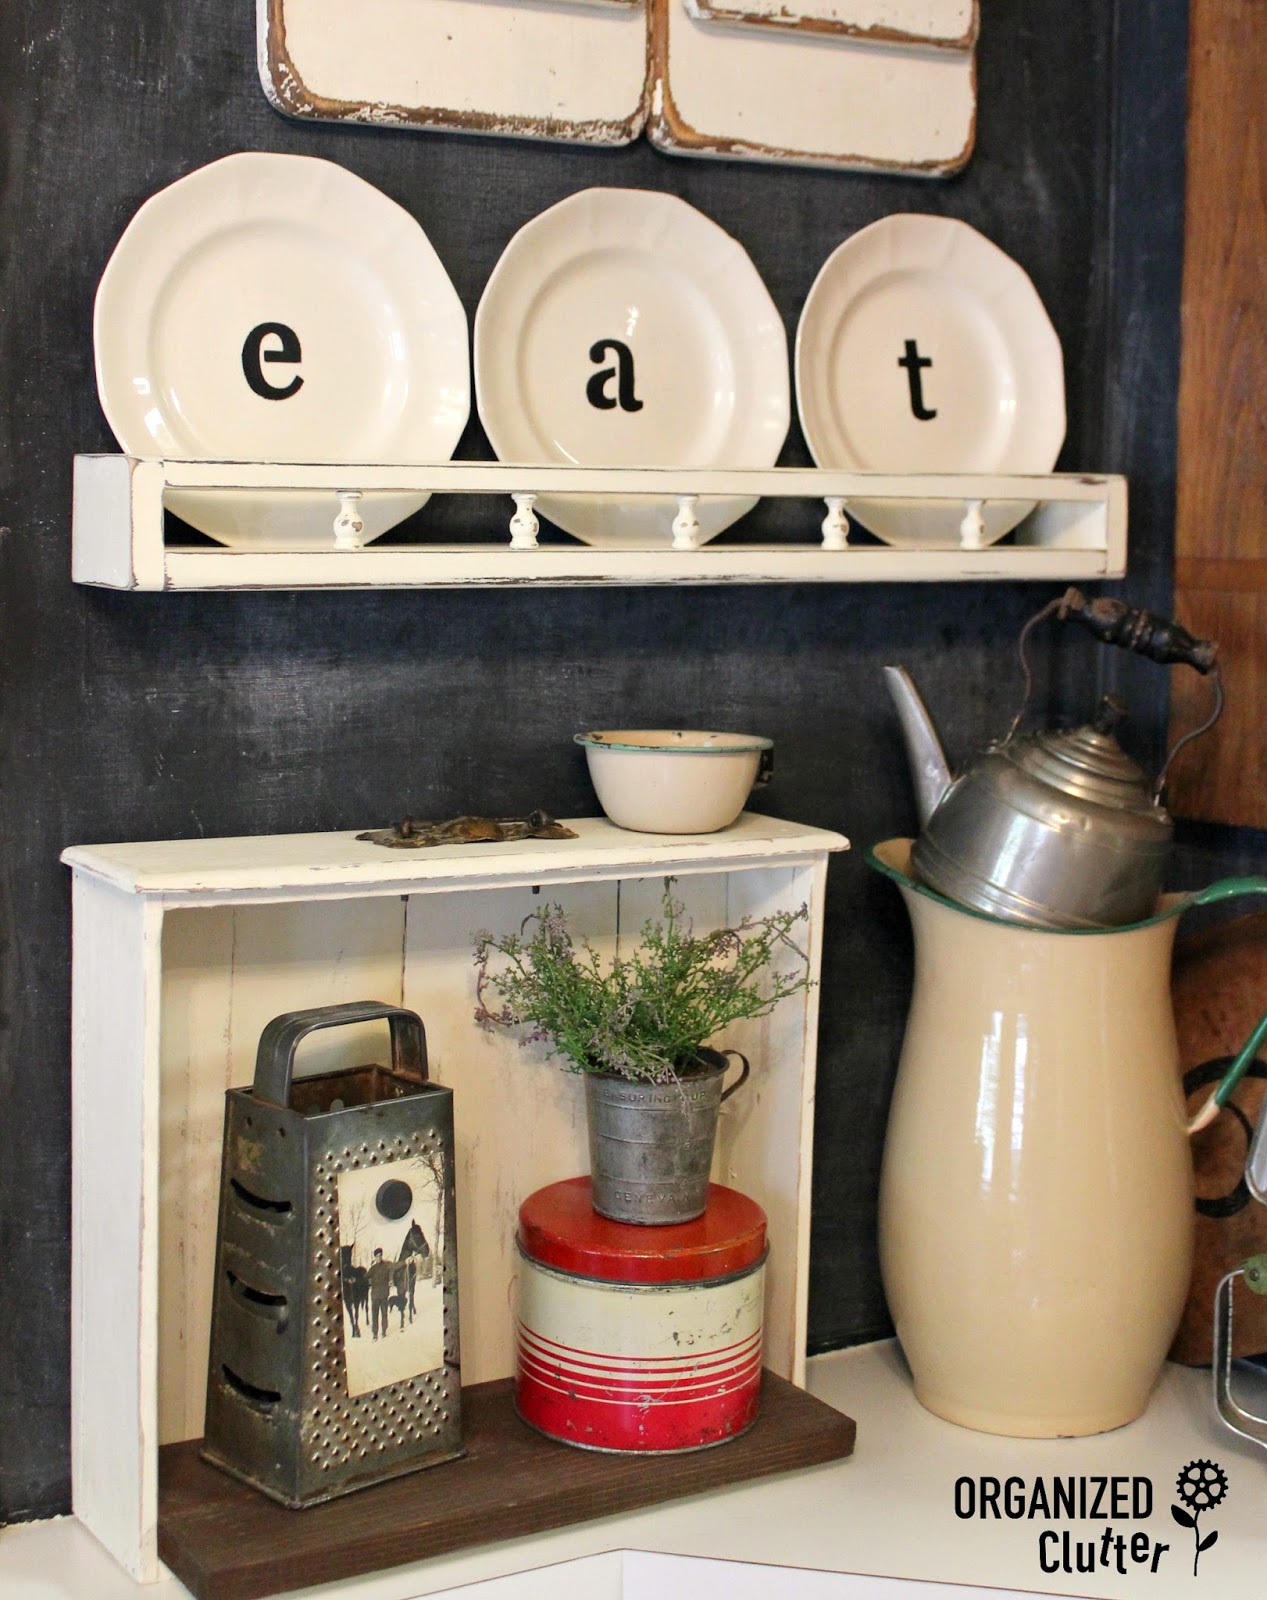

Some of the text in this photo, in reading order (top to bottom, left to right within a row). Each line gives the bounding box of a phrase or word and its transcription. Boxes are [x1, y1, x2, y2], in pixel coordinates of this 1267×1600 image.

[242, 323, 937, 421] e a t
